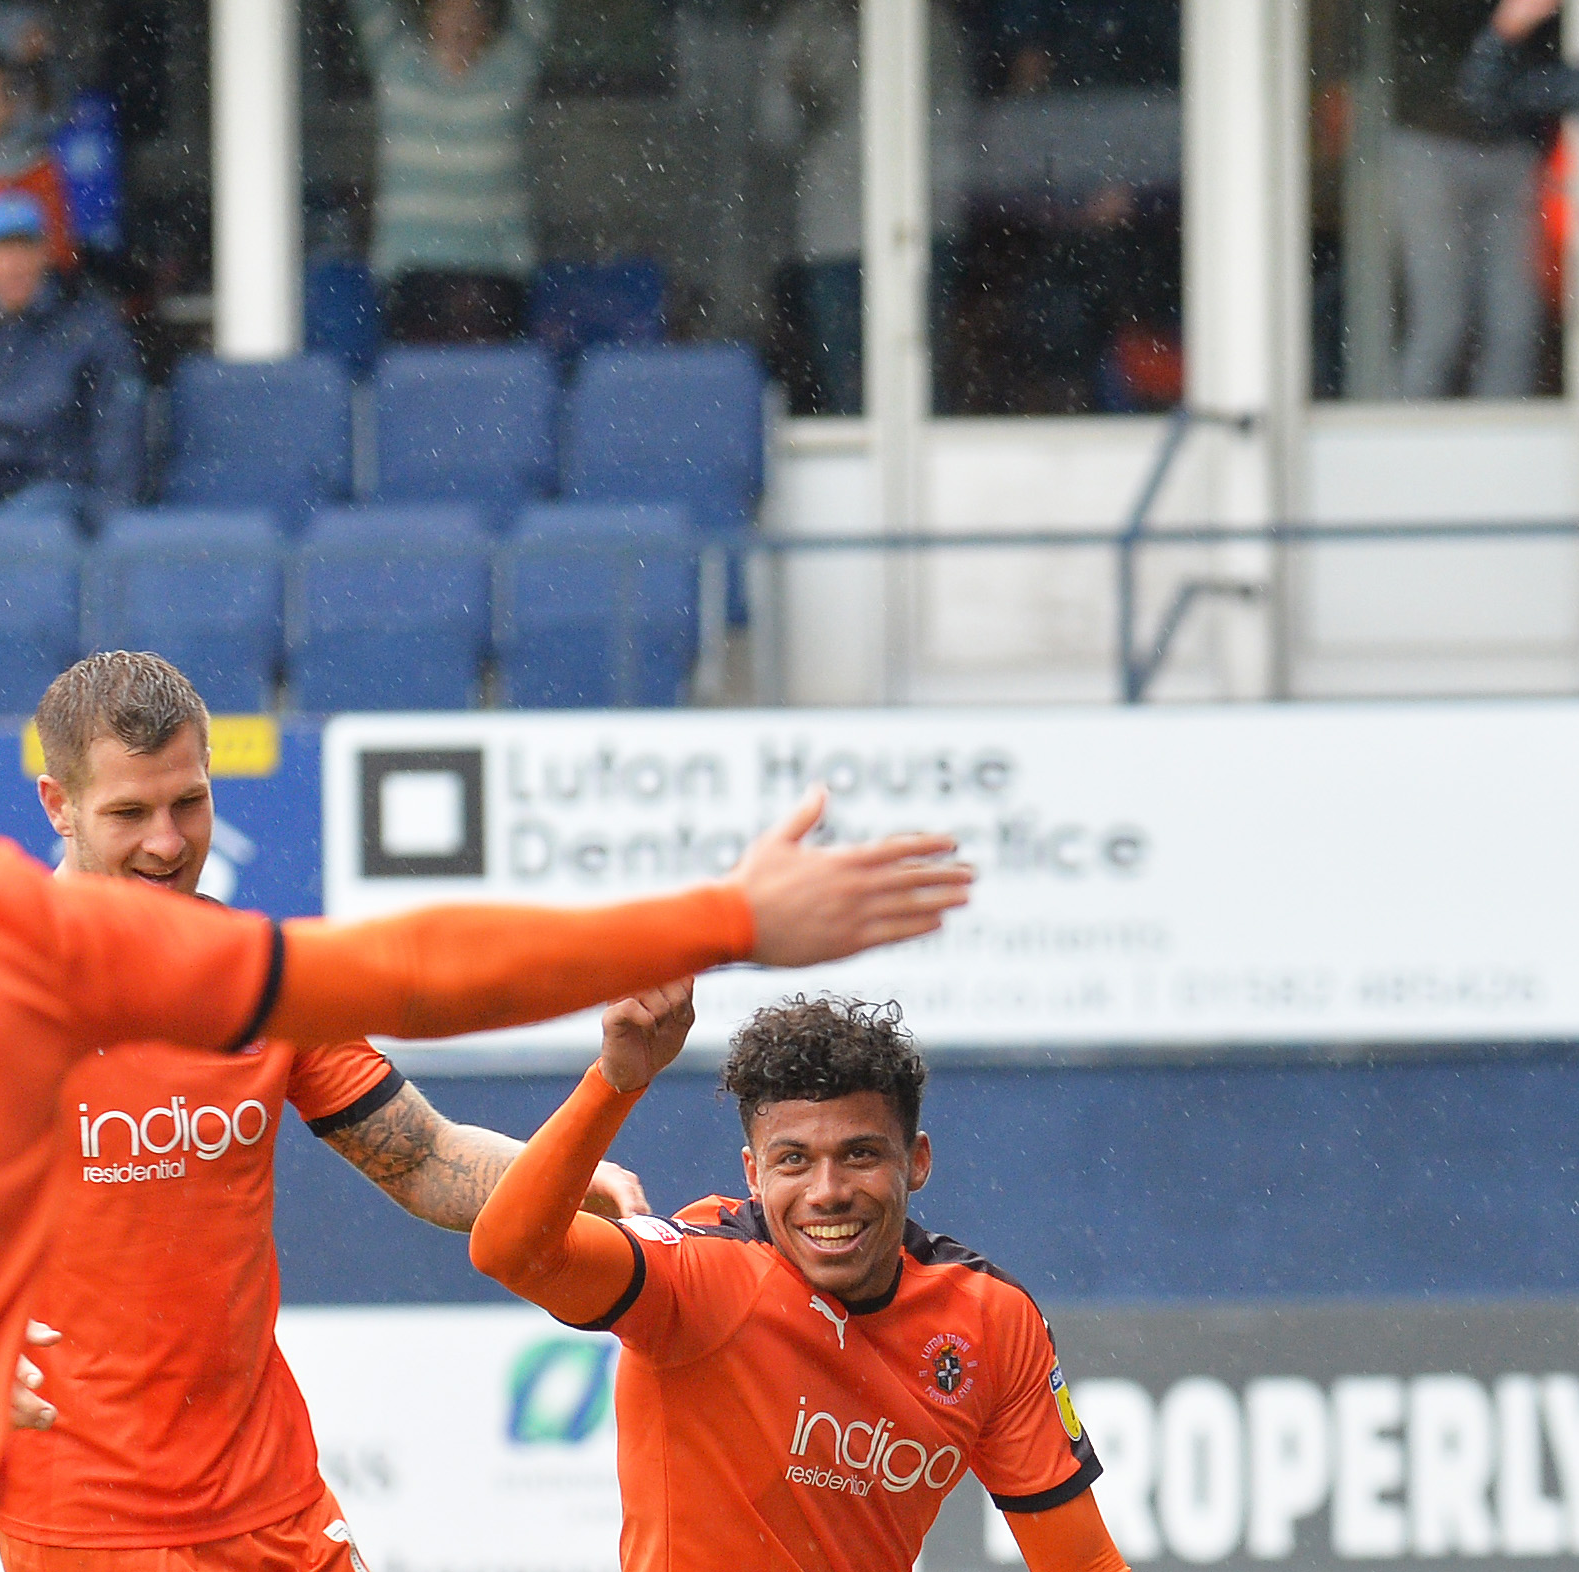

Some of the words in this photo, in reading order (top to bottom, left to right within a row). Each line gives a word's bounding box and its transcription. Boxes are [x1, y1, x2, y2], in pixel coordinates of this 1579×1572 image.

[506, 738, 721, 799] Luton
[759, 738, 1016, 799] House
[506, 815, 757, 880] Denta
[78, 1096, 268, 1160] indigo
[82, 1158, 185, 1184] residential
[921, 1333, 944, 1359] LUTON
[945, 1333, 971, 1353] TOWN
[788, 1395, 962, 1493] indigo
[784, 1464, 874, 1498] residential
